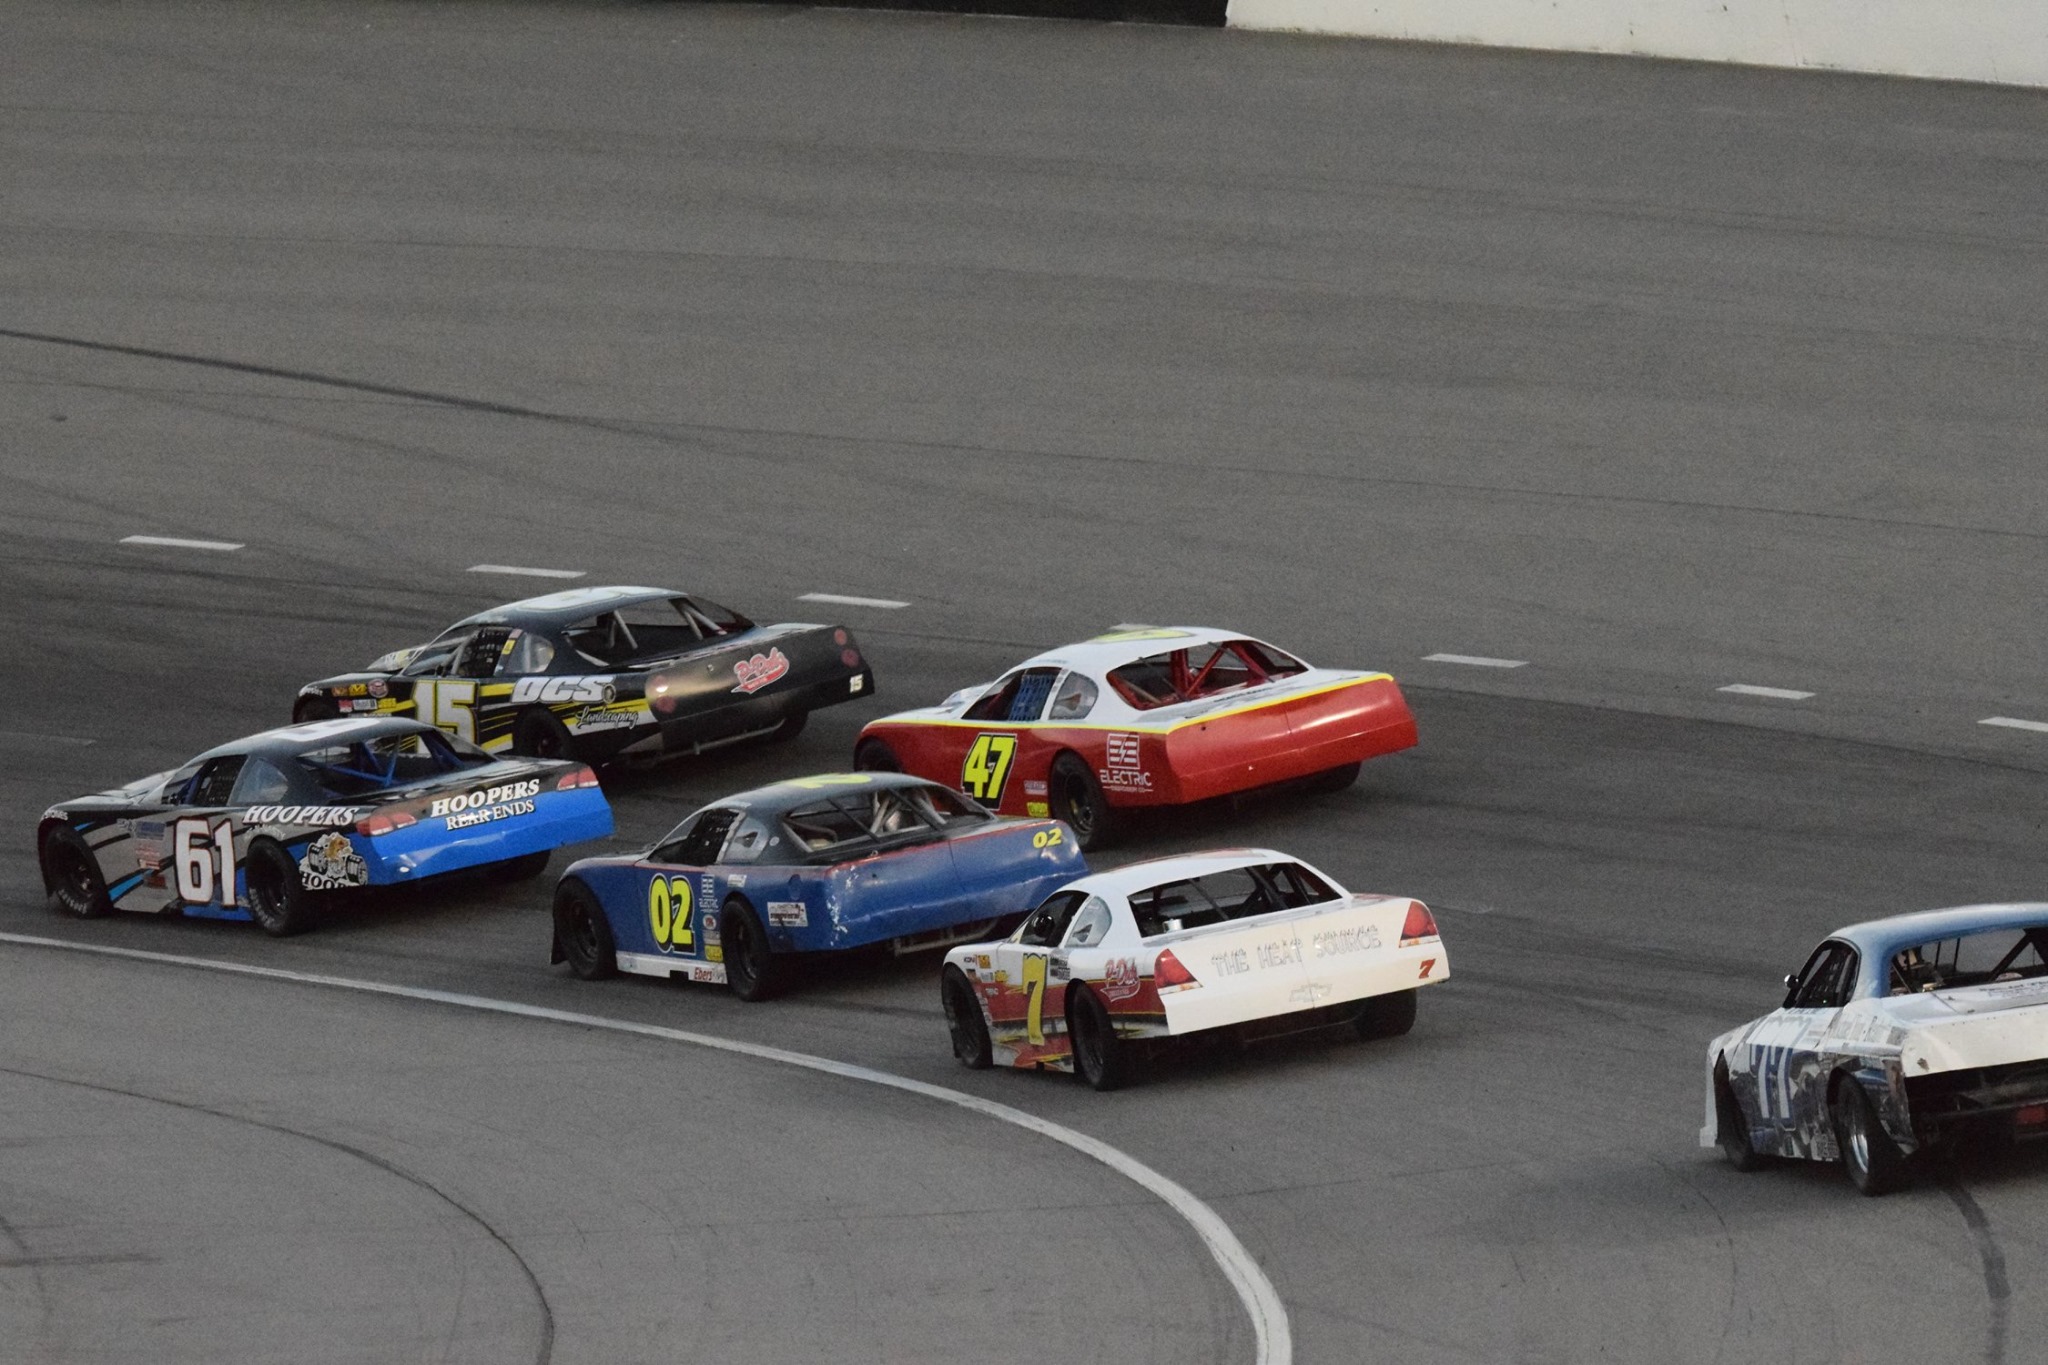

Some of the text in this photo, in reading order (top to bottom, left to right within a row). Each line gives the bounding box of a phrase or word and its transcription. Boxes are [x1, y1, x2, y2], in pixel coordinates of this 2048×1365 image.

[850, 674, 863, 693] 15
[412, 680, 478, 749] 15
[575, 705, 640, 729] Landscaping
[962, 733, 1017, 806] 47
[1099, 769, 1152, 787] ELECTRIC
[242, 805, 361, 827] HOOPERS
[431, 779, 540, 818] HOOPERS
[446, 799, 535, 831] REAR ENDS
[1033, 828, 1062, 849] 02
[174, 817, 238, 907] 61
[649, 874, 695, 954] 02
[1211, 924, 1383, 977] THE HEAT SOURCE
[1419, 958, 1436, 979] 7
[1022, 953, 1047, 1046] 7
